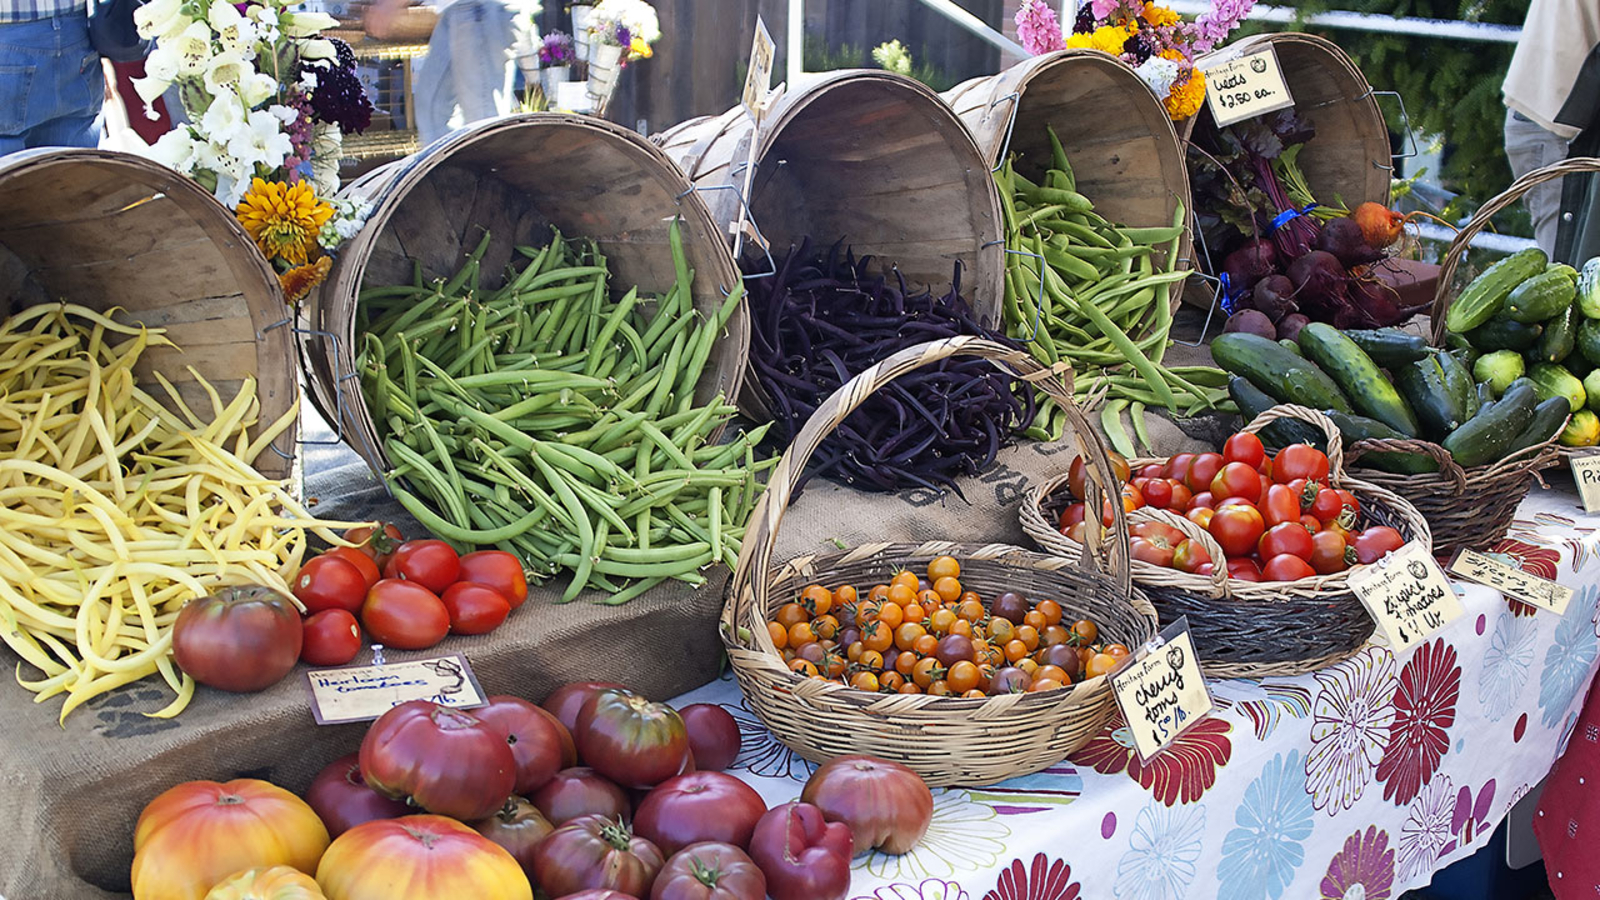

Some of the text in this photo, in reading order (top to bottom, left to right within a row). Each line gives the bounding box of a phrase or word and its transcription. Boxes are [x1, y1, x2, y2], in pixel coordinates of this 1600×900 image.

[1228, 62, 1245, 72] Farm
[1219, 88, 1276, 108] $2.50 ea.
[1383, 570, 1404, 583] Farm
[1116, 660, 1162, 693] Heritage Farm
